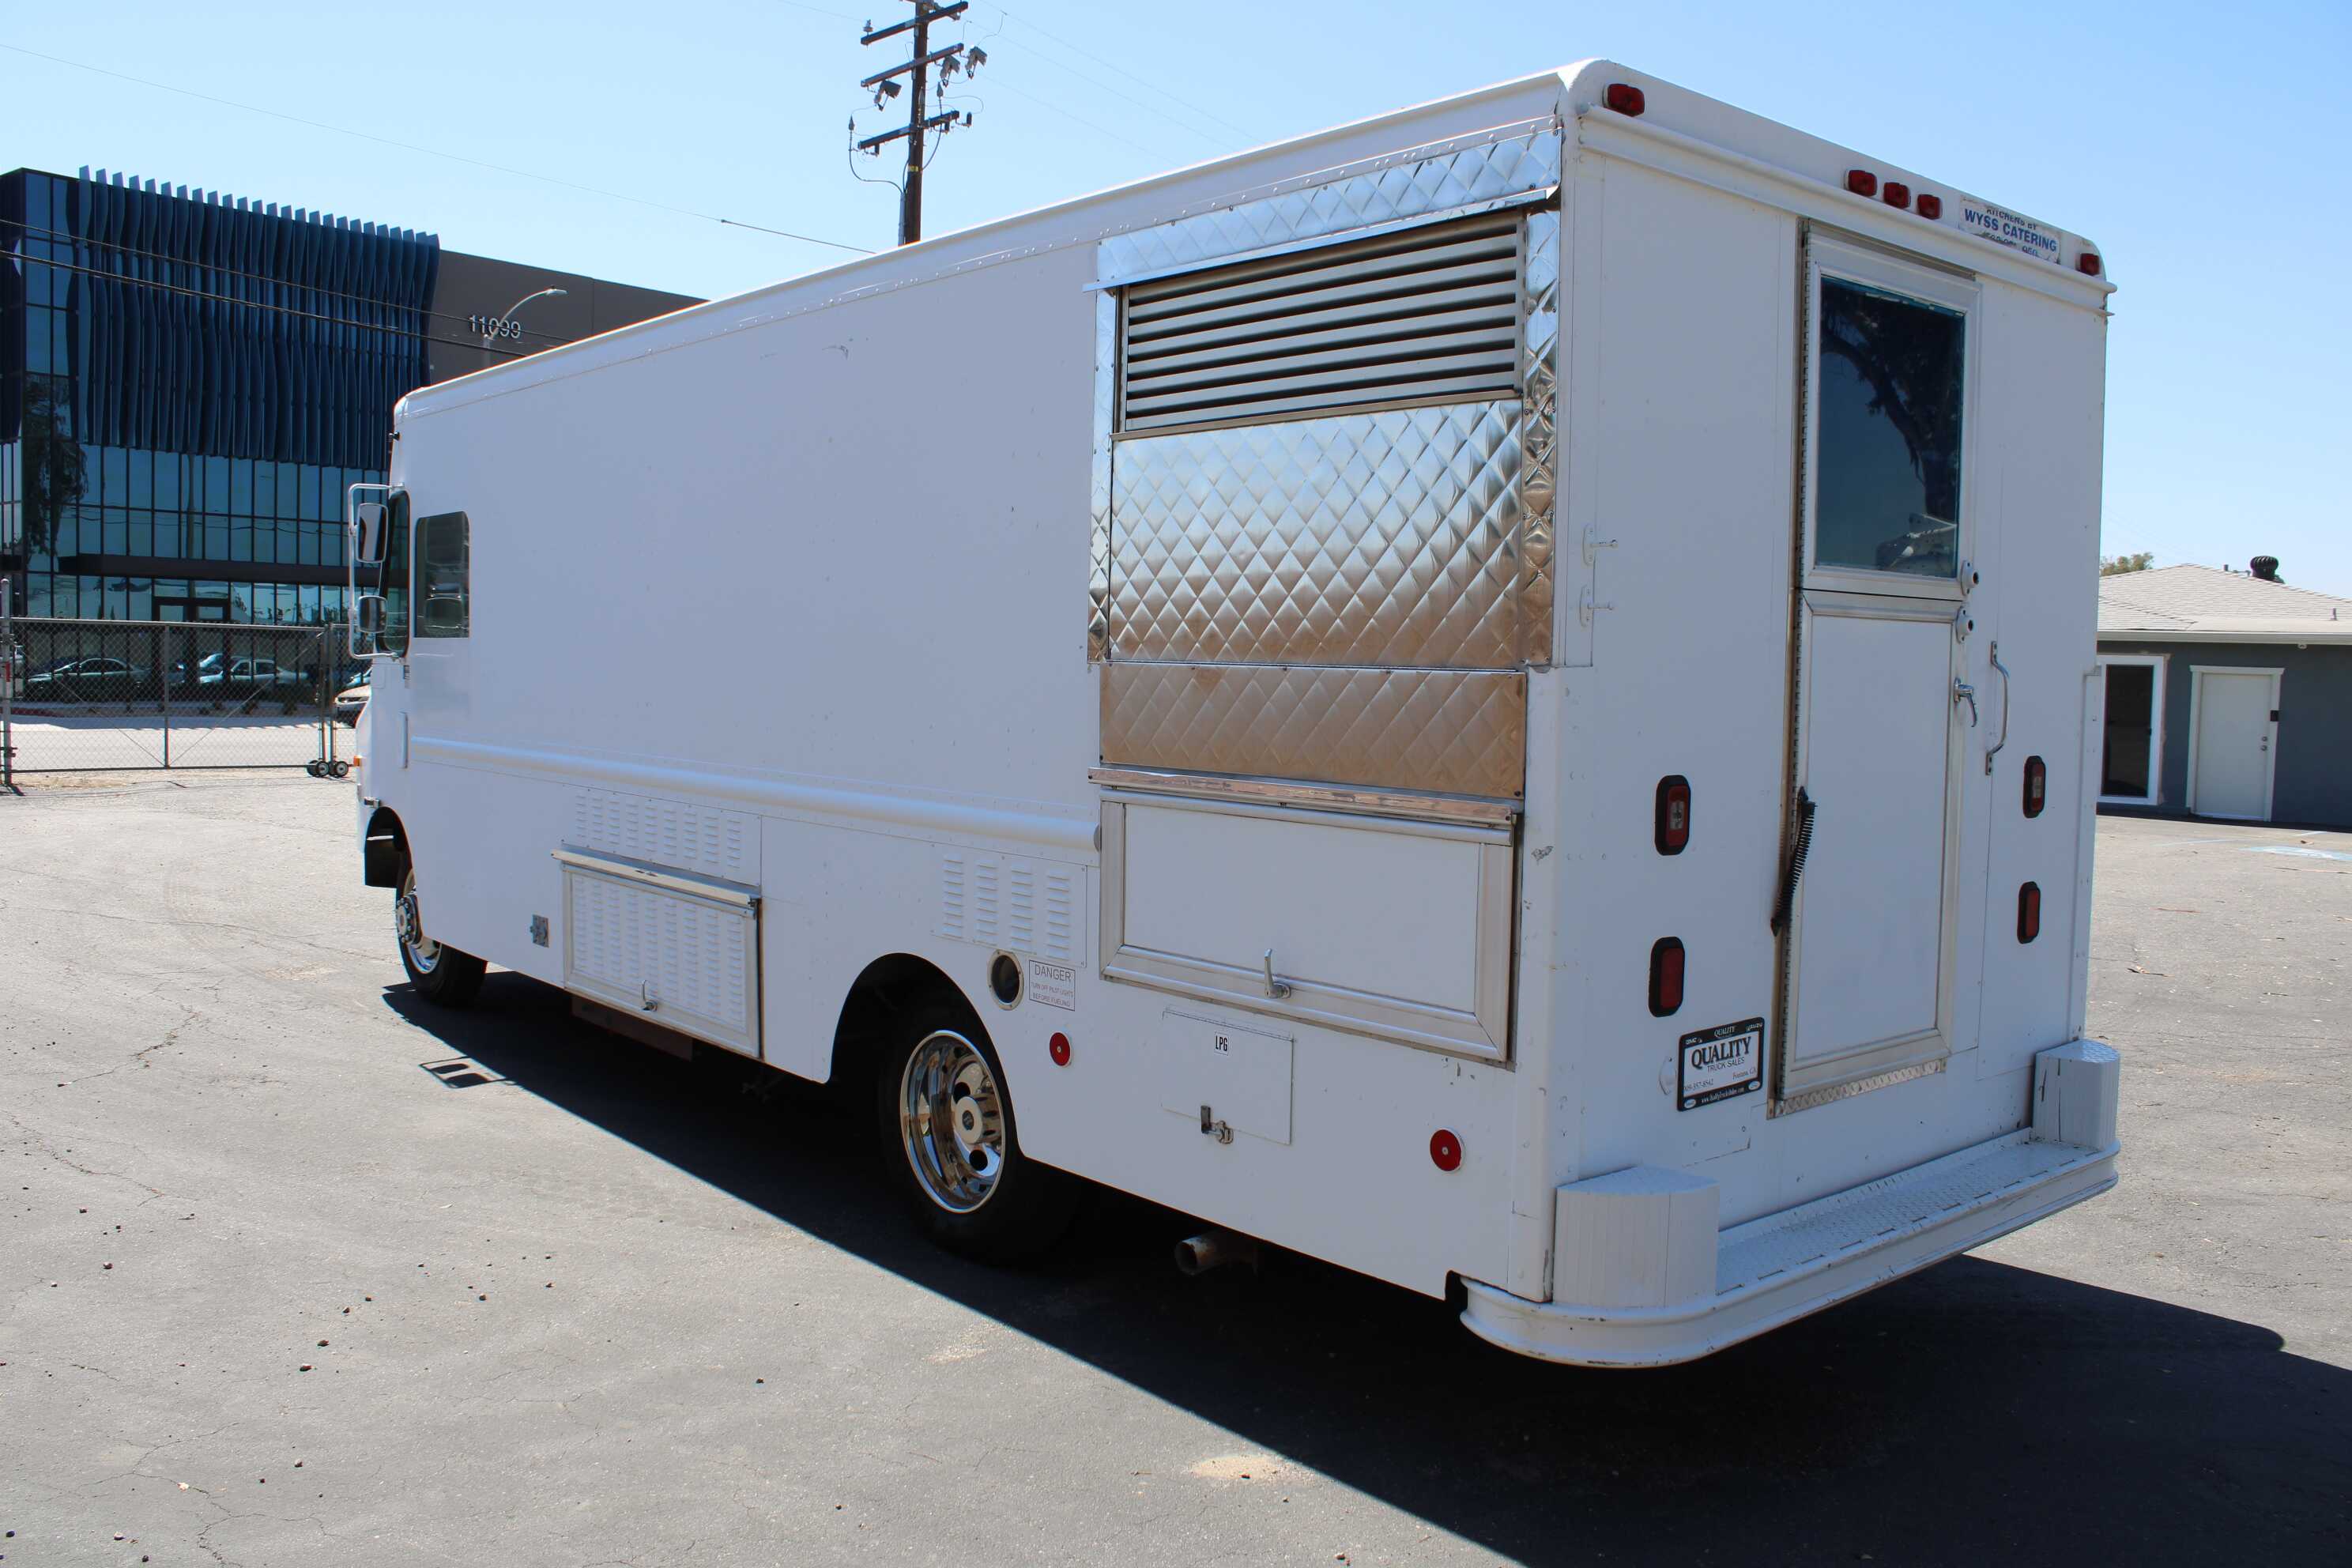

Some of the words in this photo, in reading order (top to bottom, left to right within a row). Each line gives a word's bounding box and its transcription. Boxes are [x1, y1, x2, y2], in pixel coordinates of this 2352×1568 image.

[1964, 208, 1999, 231] WYSS
[2002, 223, 2057, 252] CATERING
[469, 315, 521, 339] 11099
[1035, 964, 1071, 982] DANGER
[1714, 1026, 1736, 1037] QUALITY
[1216, 1035, 1228, 1052] LPG
[1691, 1036, 1752, 1070] QUALITY
[1726, 1057, 1745, 1068] SALES
